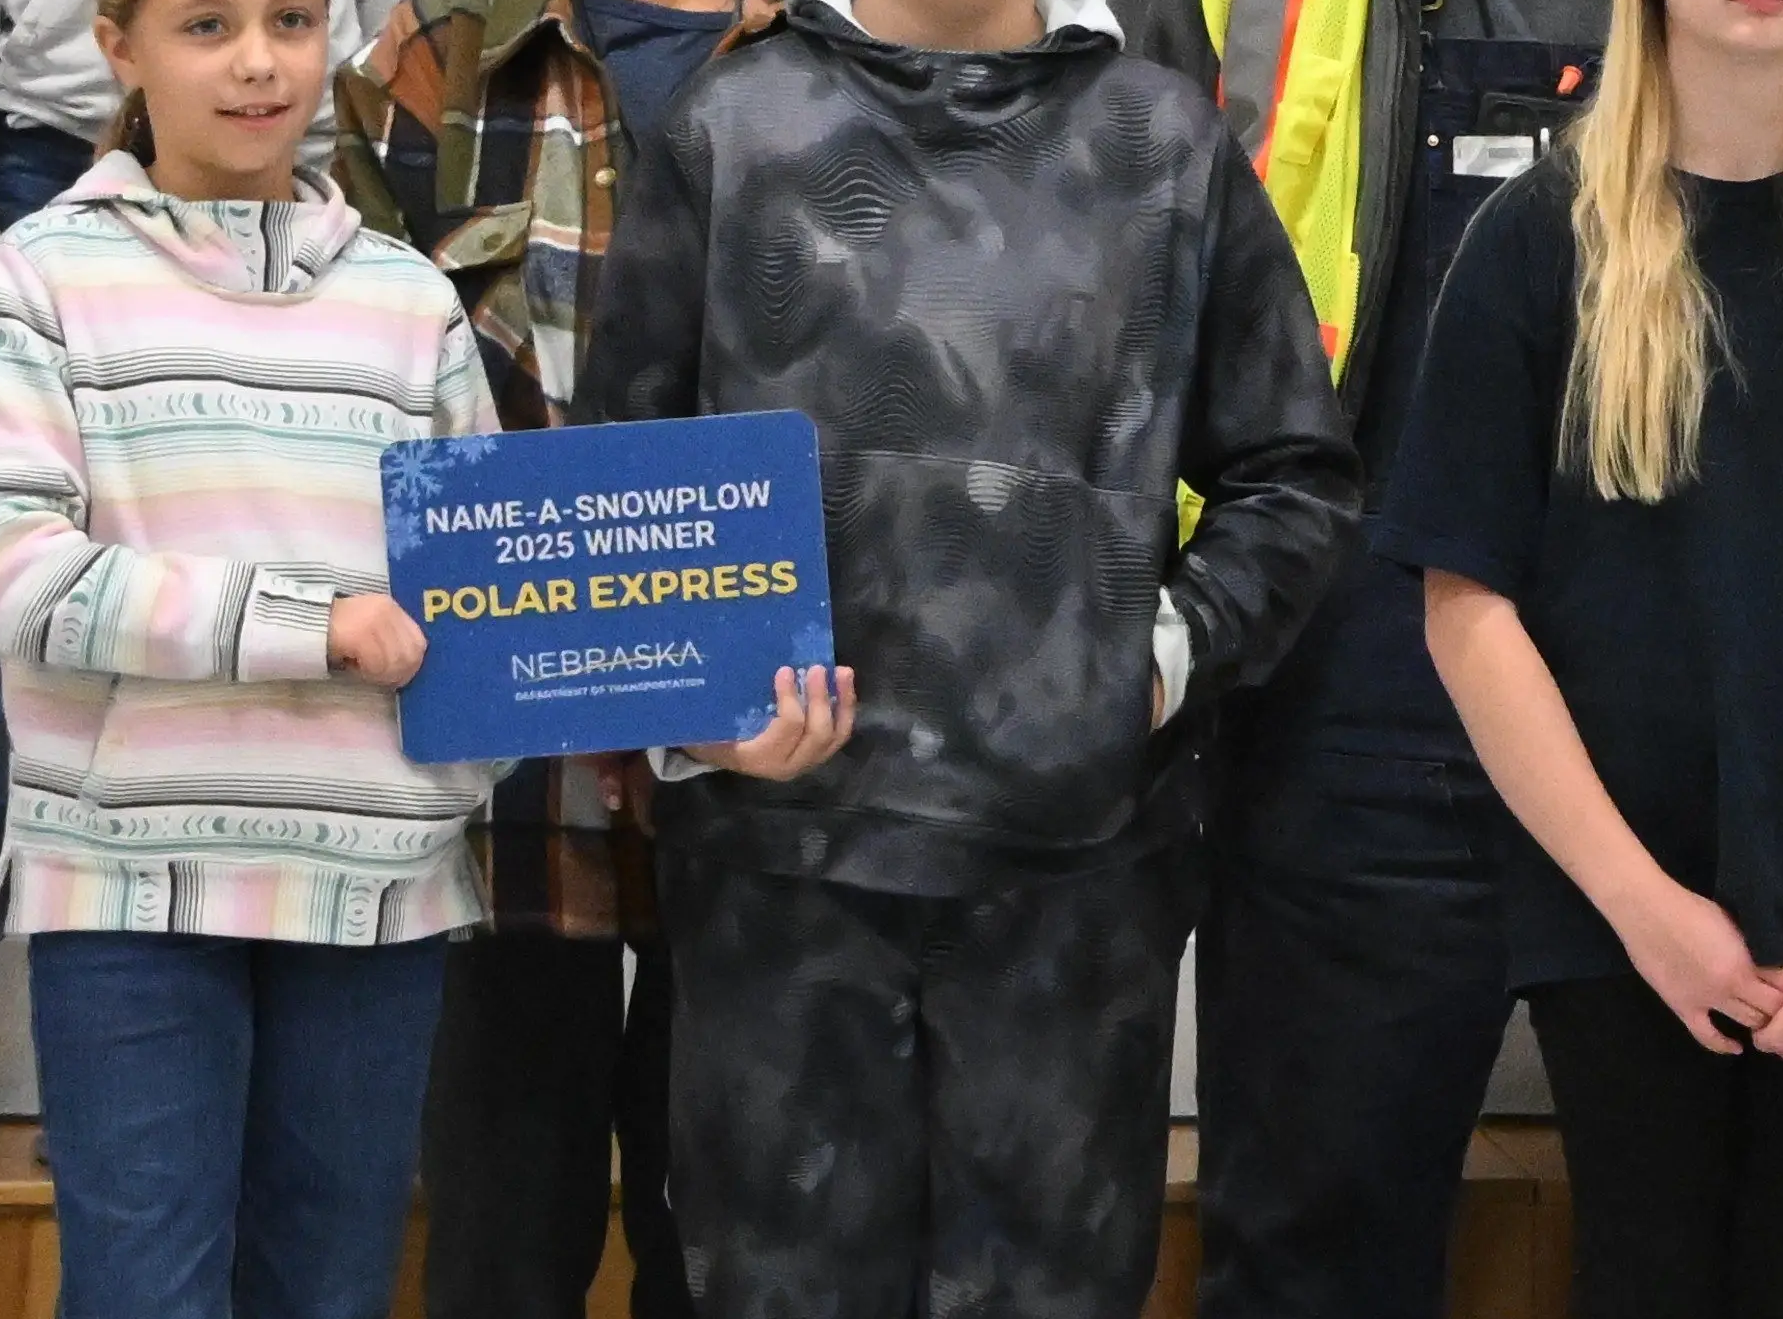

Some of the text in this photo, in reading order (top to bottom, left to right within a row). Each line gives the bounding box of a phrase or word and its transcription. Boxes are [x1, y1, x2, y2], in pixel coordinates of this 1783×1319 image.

[425, 480, 772, 534] NAME-A-SNOWPLOW
[496, 520, 715, 564] 2025 WINNER
[423, 561, 798, 623] POLAR EXPRESS
[511, 641, 703, 680] NEBRASKA
